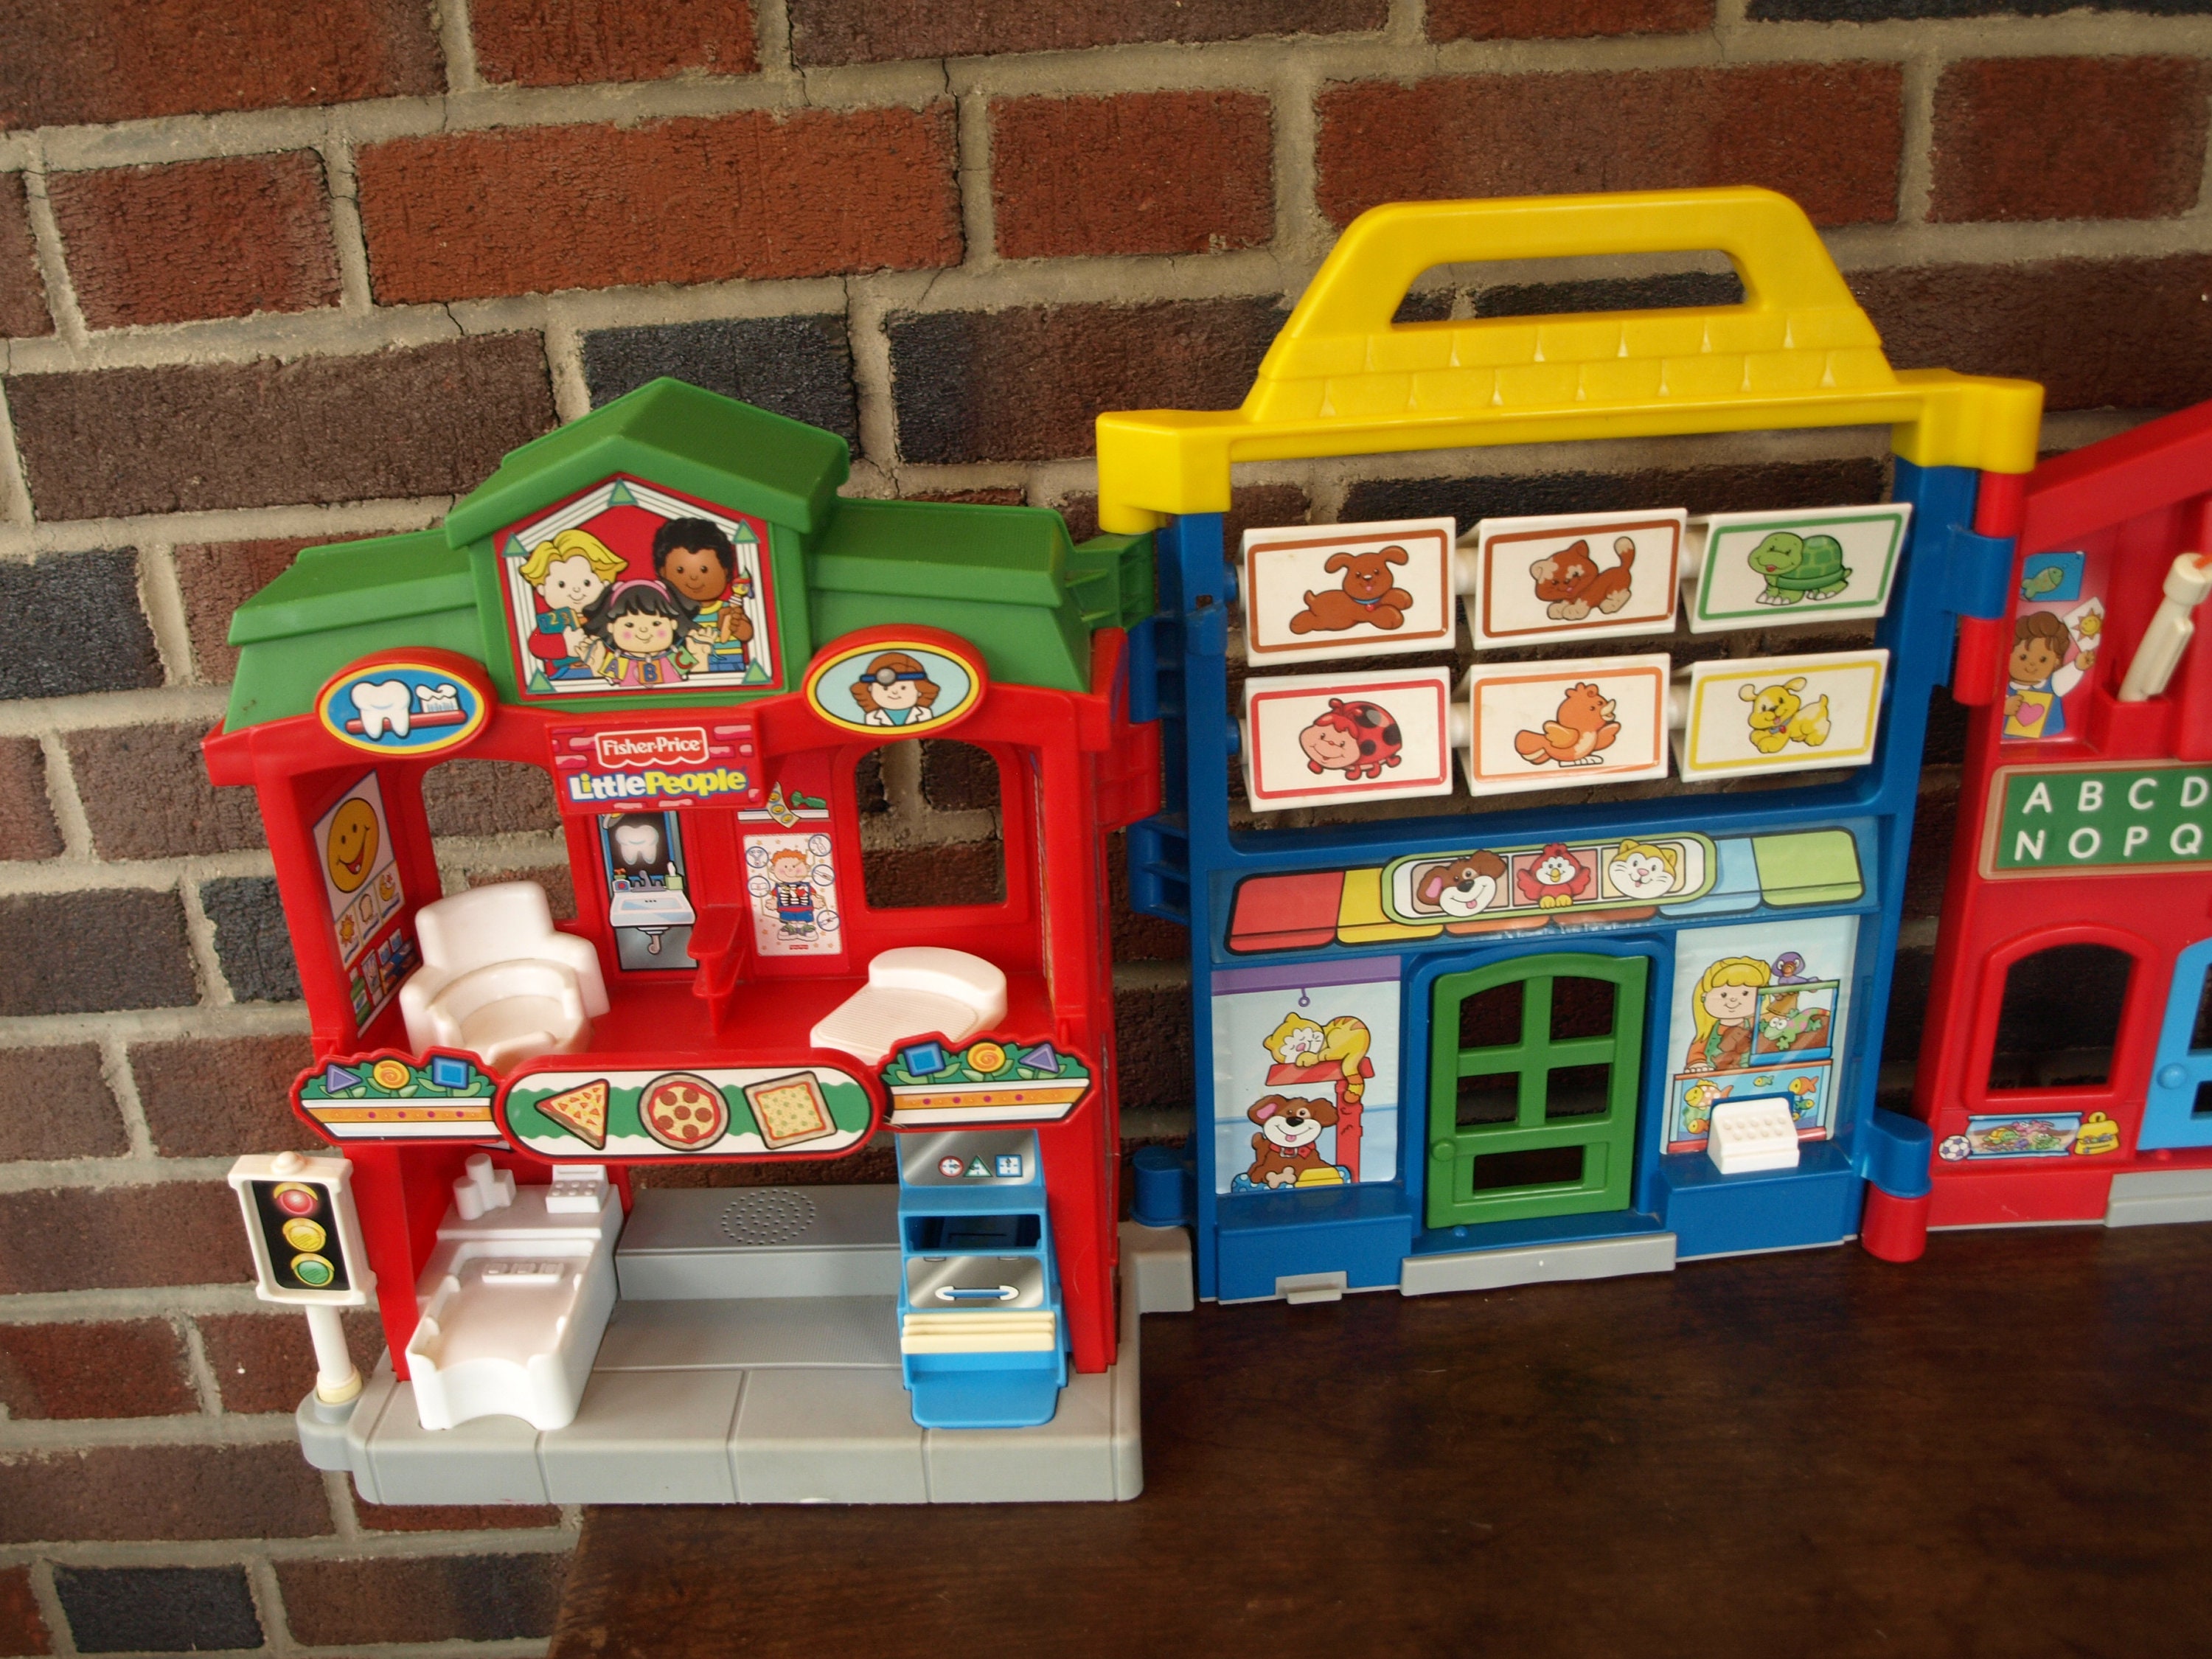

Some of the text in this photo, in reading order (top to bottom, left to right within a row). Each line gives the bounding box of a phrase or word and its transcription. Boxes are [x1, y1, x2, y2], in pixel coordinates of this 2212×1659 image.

[548, 611, 560, 626] 2
[604, 650, 694, 682] A B C
[602, 736, 701, 756] Fisher-Price
[2023, 776, 2209, 814] A B C D
[2014, 823, 2202, 861] N O P Q
